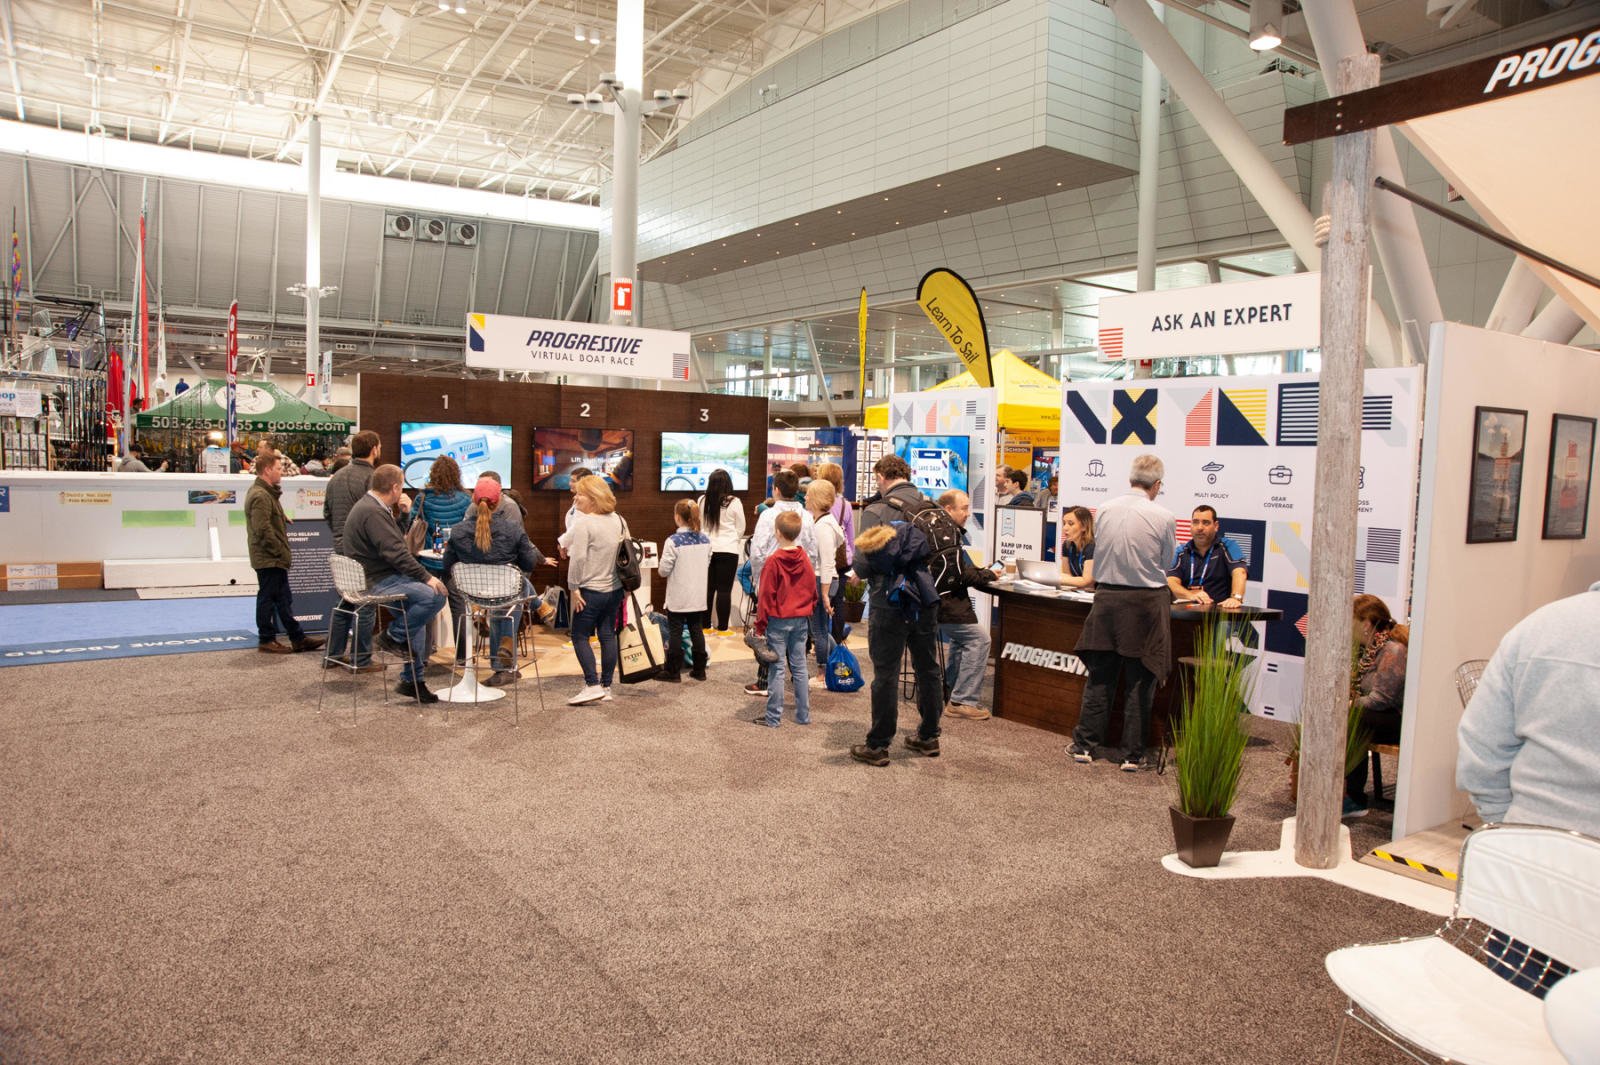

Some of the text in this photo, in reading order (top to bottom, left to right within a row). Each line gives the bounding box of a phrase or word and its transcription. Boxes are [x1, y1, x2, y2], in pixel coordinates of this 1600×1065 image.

[1483, 29, 1600, 94] PROG
[1151, 303, 1292, 332] ASK AN EXPERT
[926, 297, 953, 333] Learn
[949, 325, 963, 345] To
[959, 341, 980, 364] Sail
[526, 330, 643, 355] PROGRESSIVE
[531, 350, 635, 366] VIRTUAL BOAT RACE
[441, 394, 449, 409] 1
[580, 403, 591, 417] 2
[152, 416, 346, 433] 508-255-055 goose.com
[699, 408, 710, 422] 3
[4, 635, 248, 658] WELCOME ABOARD
[1000, 641, 1090, 678] PROGRESSIV
